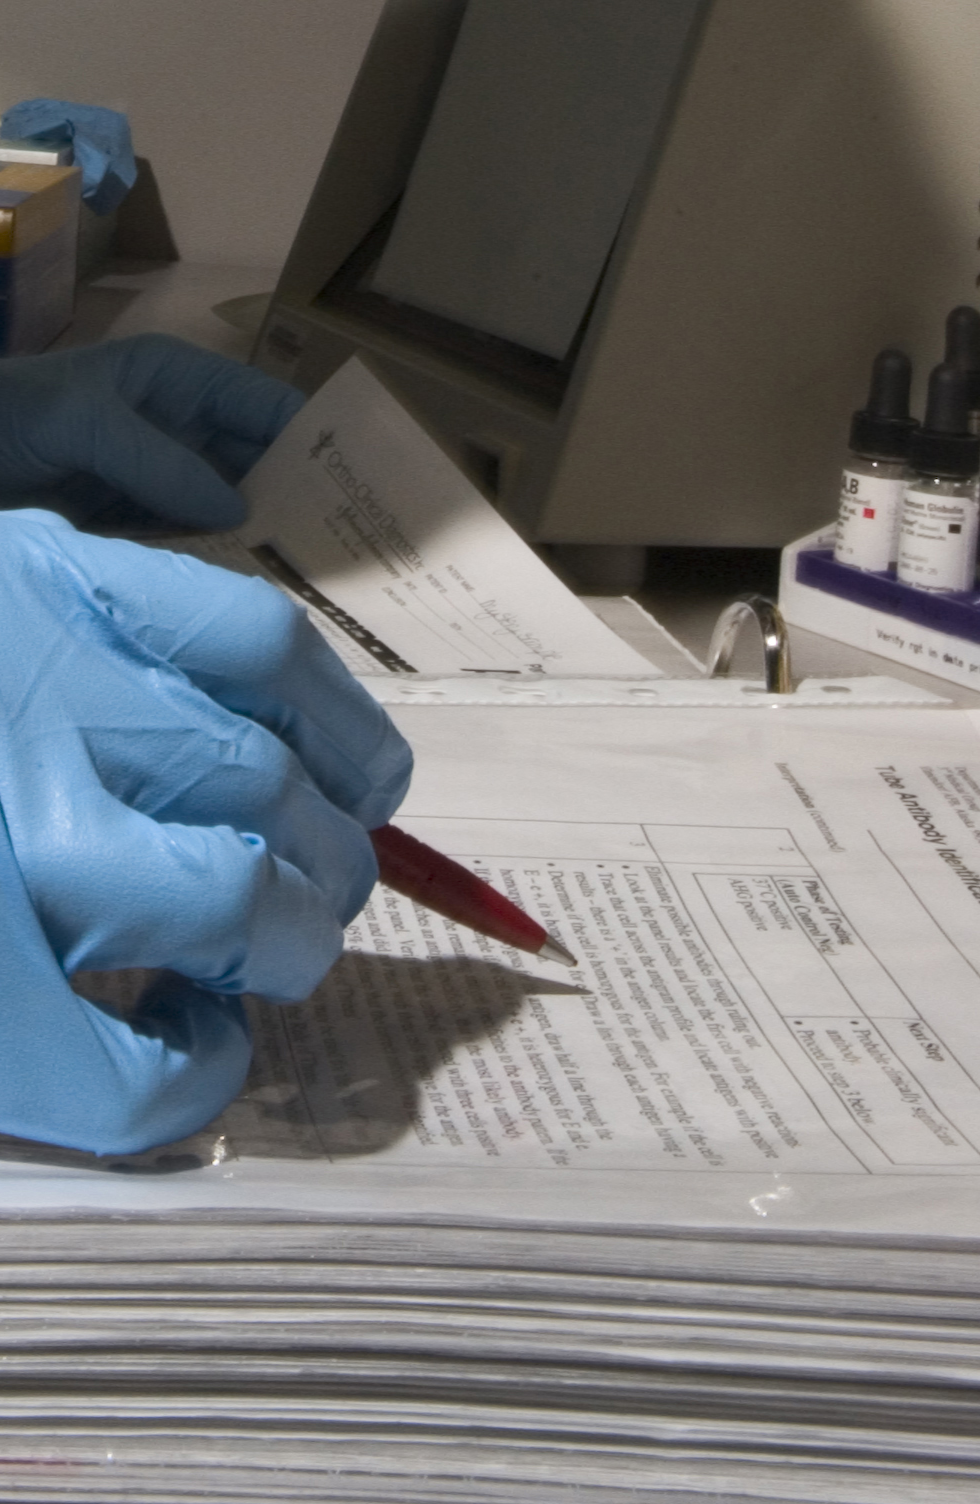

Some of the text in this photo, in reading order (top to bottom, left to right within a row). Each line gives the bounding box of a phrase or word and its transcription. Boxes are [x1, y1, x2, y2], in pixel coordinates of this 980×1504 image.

[875, 627, 905, 649] Verify
[942, 652, 964, 668] date
[878, 765, 905, 789] Tube
[898, 792, 945, 844] Antibody
[808, 809, 844, 852] (continued)
[597, 872, 617, 895] Trace
[622, 872, 645, 894] Look
[608, 896, 626, 912] that
[616, 913, 638, 928] cell
[638, 905, 654, 918] the
[728, 878, 767, 931] AHG positive
[760, 899, 791, 930] positive
[774, 878, 800, 903] (Auto
[793, 904, 826, 936] Control
[802, 879, 824, 904] Phase
[826, 916, 852, 945] Testing
[384, 910, 409, 933] panel.
[641, 918, 670, 941] panel
[644, 865, 672, 903] Eliminate
[660, 904, 691, 936] possible
[682, 938, 713, 976] antibodies
[707, 978, 736, 1007] through
[573, 870, 595, 897] results
[589, 906, 607, 926] there
[627, 980, 652, 1010] antigen
[624, 929, 647, 953] across
[658, 941, 682, 967] results
[646, 969, 675, 1004] antigram
[672, 968, 695, 983] and
[548, 870, 574, 912] Determine
[589, 960, 623, 1010] homozygous
[660, 1088, 693, 1124] example
[682, 984, 705, 1007] locate
[663, 1004, 693, 1031] profile
[825, 1029, 860, 1063] antibody.
[908, 1021, 944, 1061] Next Step
[472, 1058, 492, 1079] most
[580, 995, 601, 1017] Draw
[605, 1042, 635, 1072] through
[635, 1095, 663, 1125] antigen
[693, 1048, 718, 1071] locate
[796, 1029, 831, 1060] Proceed
[847, 1097, 872, 1123] below.
[481, 1080, 504, 1104] likely
[527, 1052, 562, 1106] heterozygous
[543, 1032, 563, 1052] draw
[576, 1093, 606, 1126] through
[709, 1073, 739, 1106] antigens
[741, 1075, 773, 1109] negative
[852, 1029, 956, 1146] Probable clinically significant
[510, 1079, 539, 1116] antibody
[742, 1129, 778, 1158] positive
